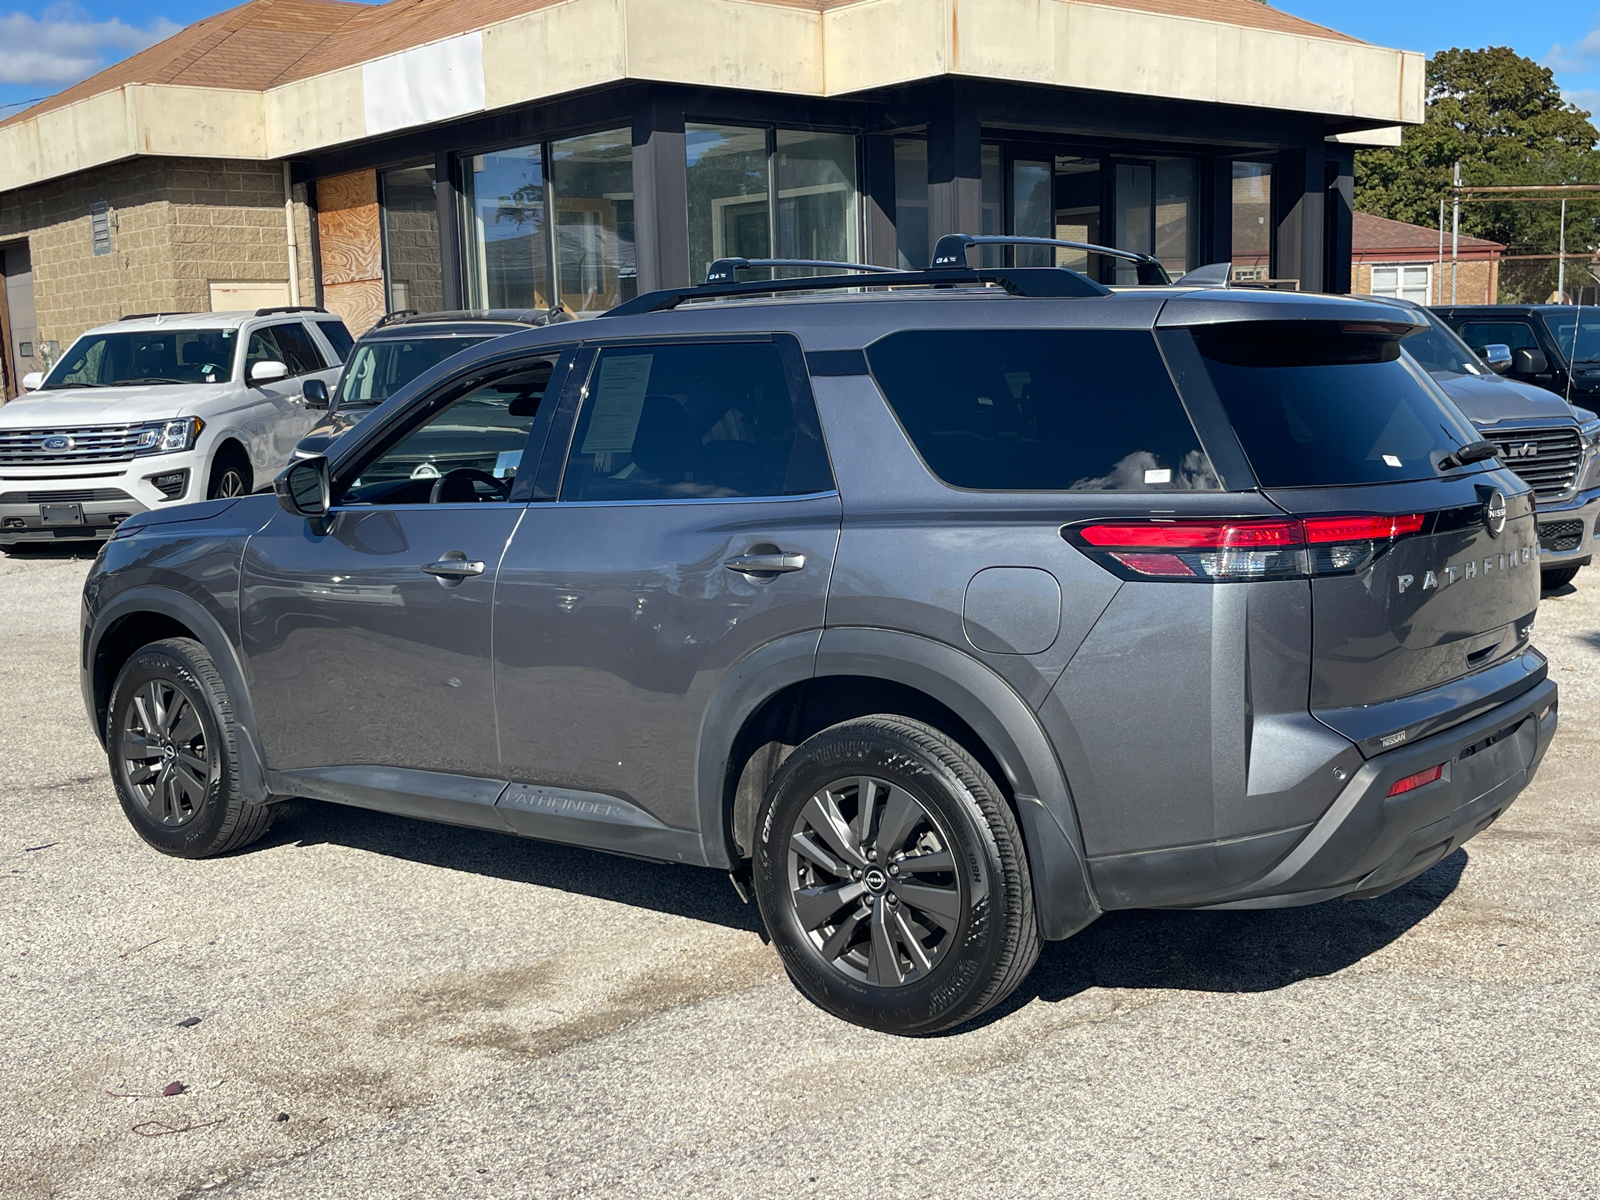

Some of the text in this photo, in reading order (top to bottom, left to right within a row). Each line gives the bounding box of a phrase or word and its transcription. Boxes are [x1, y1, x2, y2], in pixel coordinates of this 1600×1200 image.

[1495, 442, 1538, 457] AM
[1380, 730, 1406, 748] NISSAN
[505, 791, 621, 817] PATHFINDER
[968, 851, 981, 883] 108H
